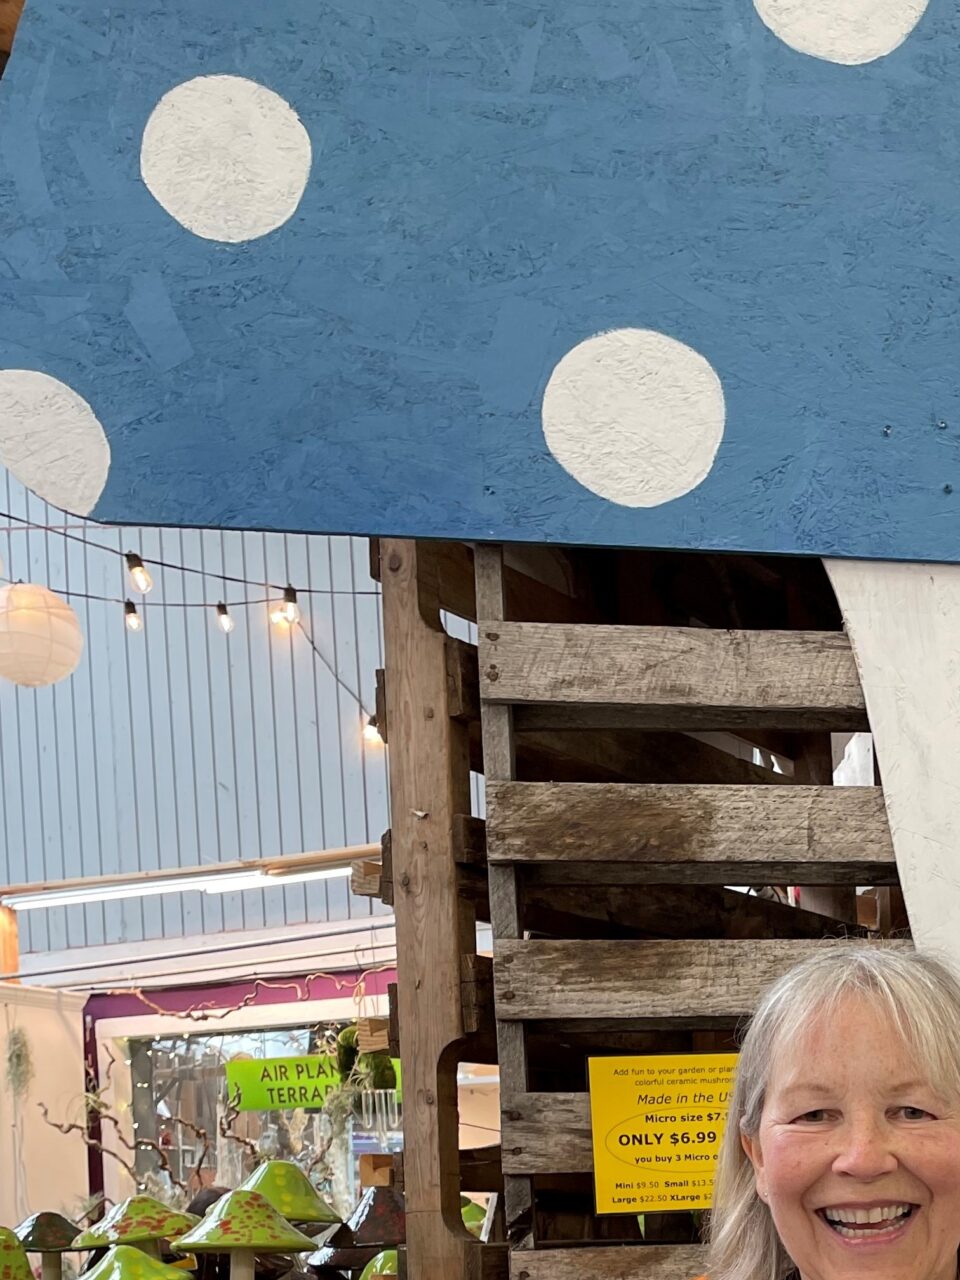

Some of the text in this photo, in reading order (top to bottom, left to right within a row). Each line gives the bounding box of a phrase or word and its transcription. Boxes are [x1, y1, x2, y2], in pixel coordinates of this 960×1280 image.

[261, 1065, 289, 1082] AIR
[613, 1068, 629, 1076] Add
[657, 1067, 676, 1076] your
[678, 1066, 706, 1075] garden
[718, 1065, 737, 1074] plan
[635, 1078, 664, 1086] colorful
[666, 1077, 698, 1085] ceramic
[637, 1094, 672, 1105] Made
[677, 1093, 688, 1104] in
[693, 1092, 714, 1103] the
[645, 1113, 676, 1123] Micro
[680, 1113, 703, 1122] size
[618, 1131, 717, 1147] ONLY $6.99
[635, 1156, 652, 1164] you
[655, 1154, 673, 1163] buy
[684, 1153, 710, 1161] Micro
[615, 1182, 634, 1190] Mini
[636, 1181, 659, 1189] $9.50
[664, 1180, 689, 1188] Small
[612, 1196, 637, 1204] Large
[670, 1193, 701, 1202] XLarge
